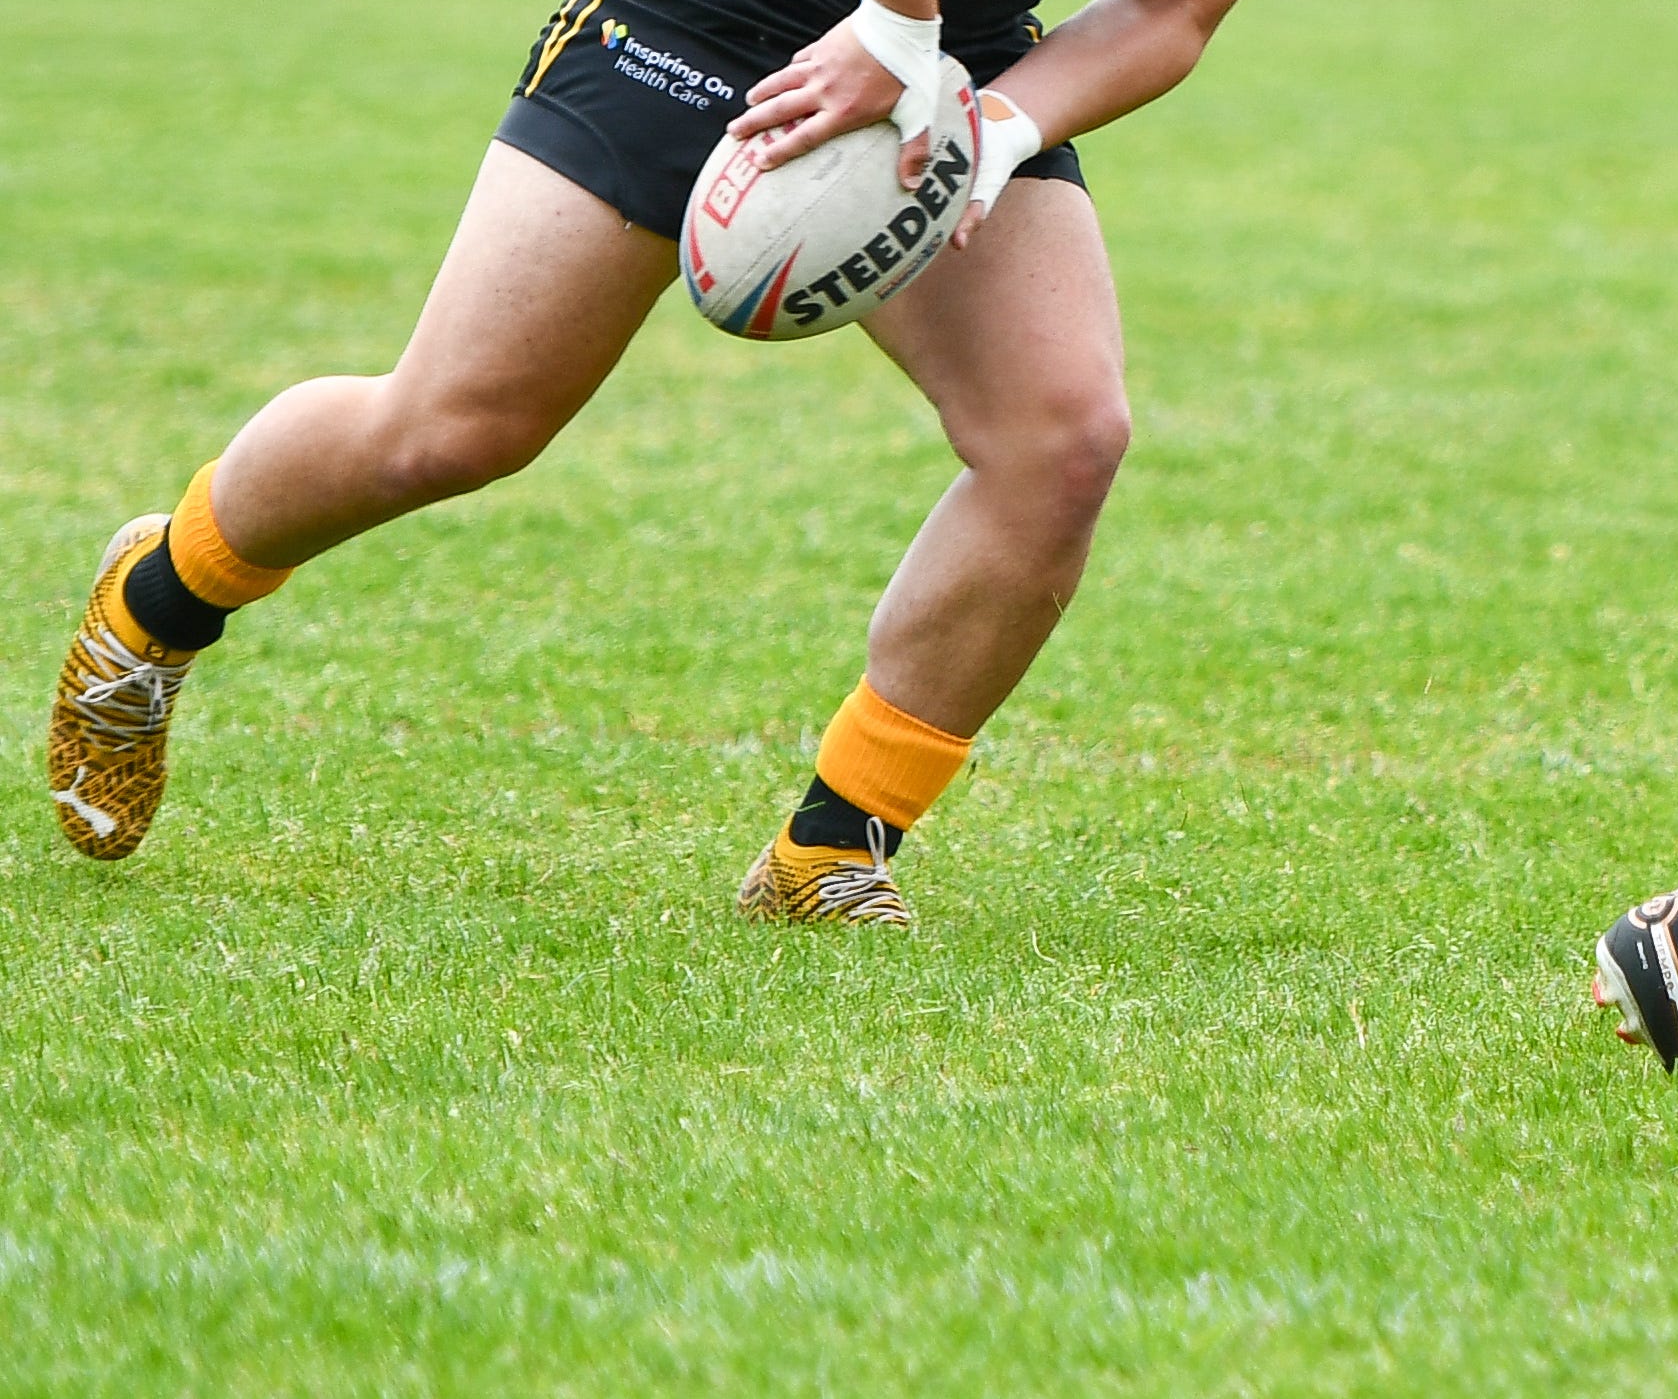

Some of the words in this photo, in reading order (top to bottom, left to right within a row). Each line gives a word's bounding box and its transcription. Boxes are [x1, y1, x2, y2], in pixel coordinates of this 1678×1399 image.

[614, 55, 669, 90] Health
[668, 81, 711, 110] Care
[624, 37, 705, 87] Inspiring
[704, 76, 735, 100] On
[784, 140, 970, 326] STEEDEN
